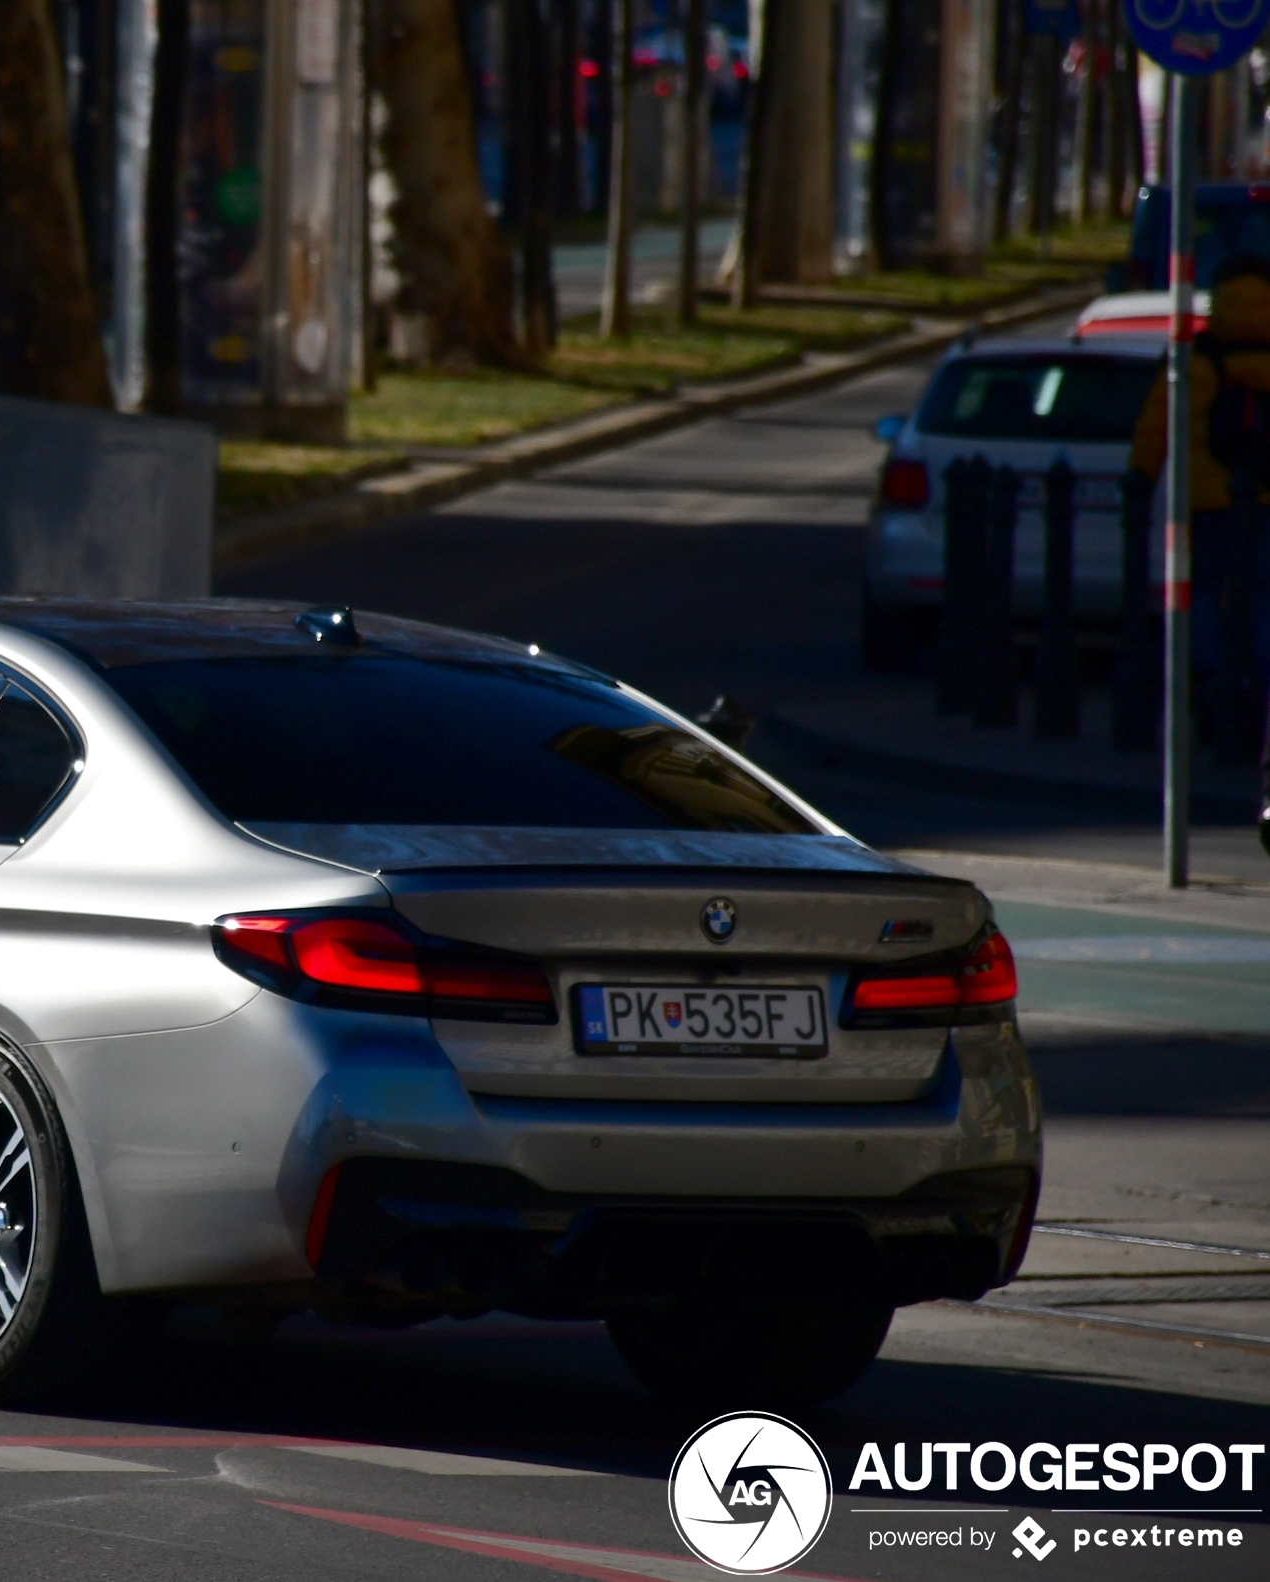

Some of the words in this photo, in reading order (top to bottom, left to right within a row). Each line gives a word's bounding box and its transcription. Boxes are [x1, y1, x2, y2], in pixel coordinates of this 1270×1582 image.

[588, 1021, 604, 1035] SK
[609, 991, 663, 1039] PK
[684, 992, 817, 1041] 535FJ
